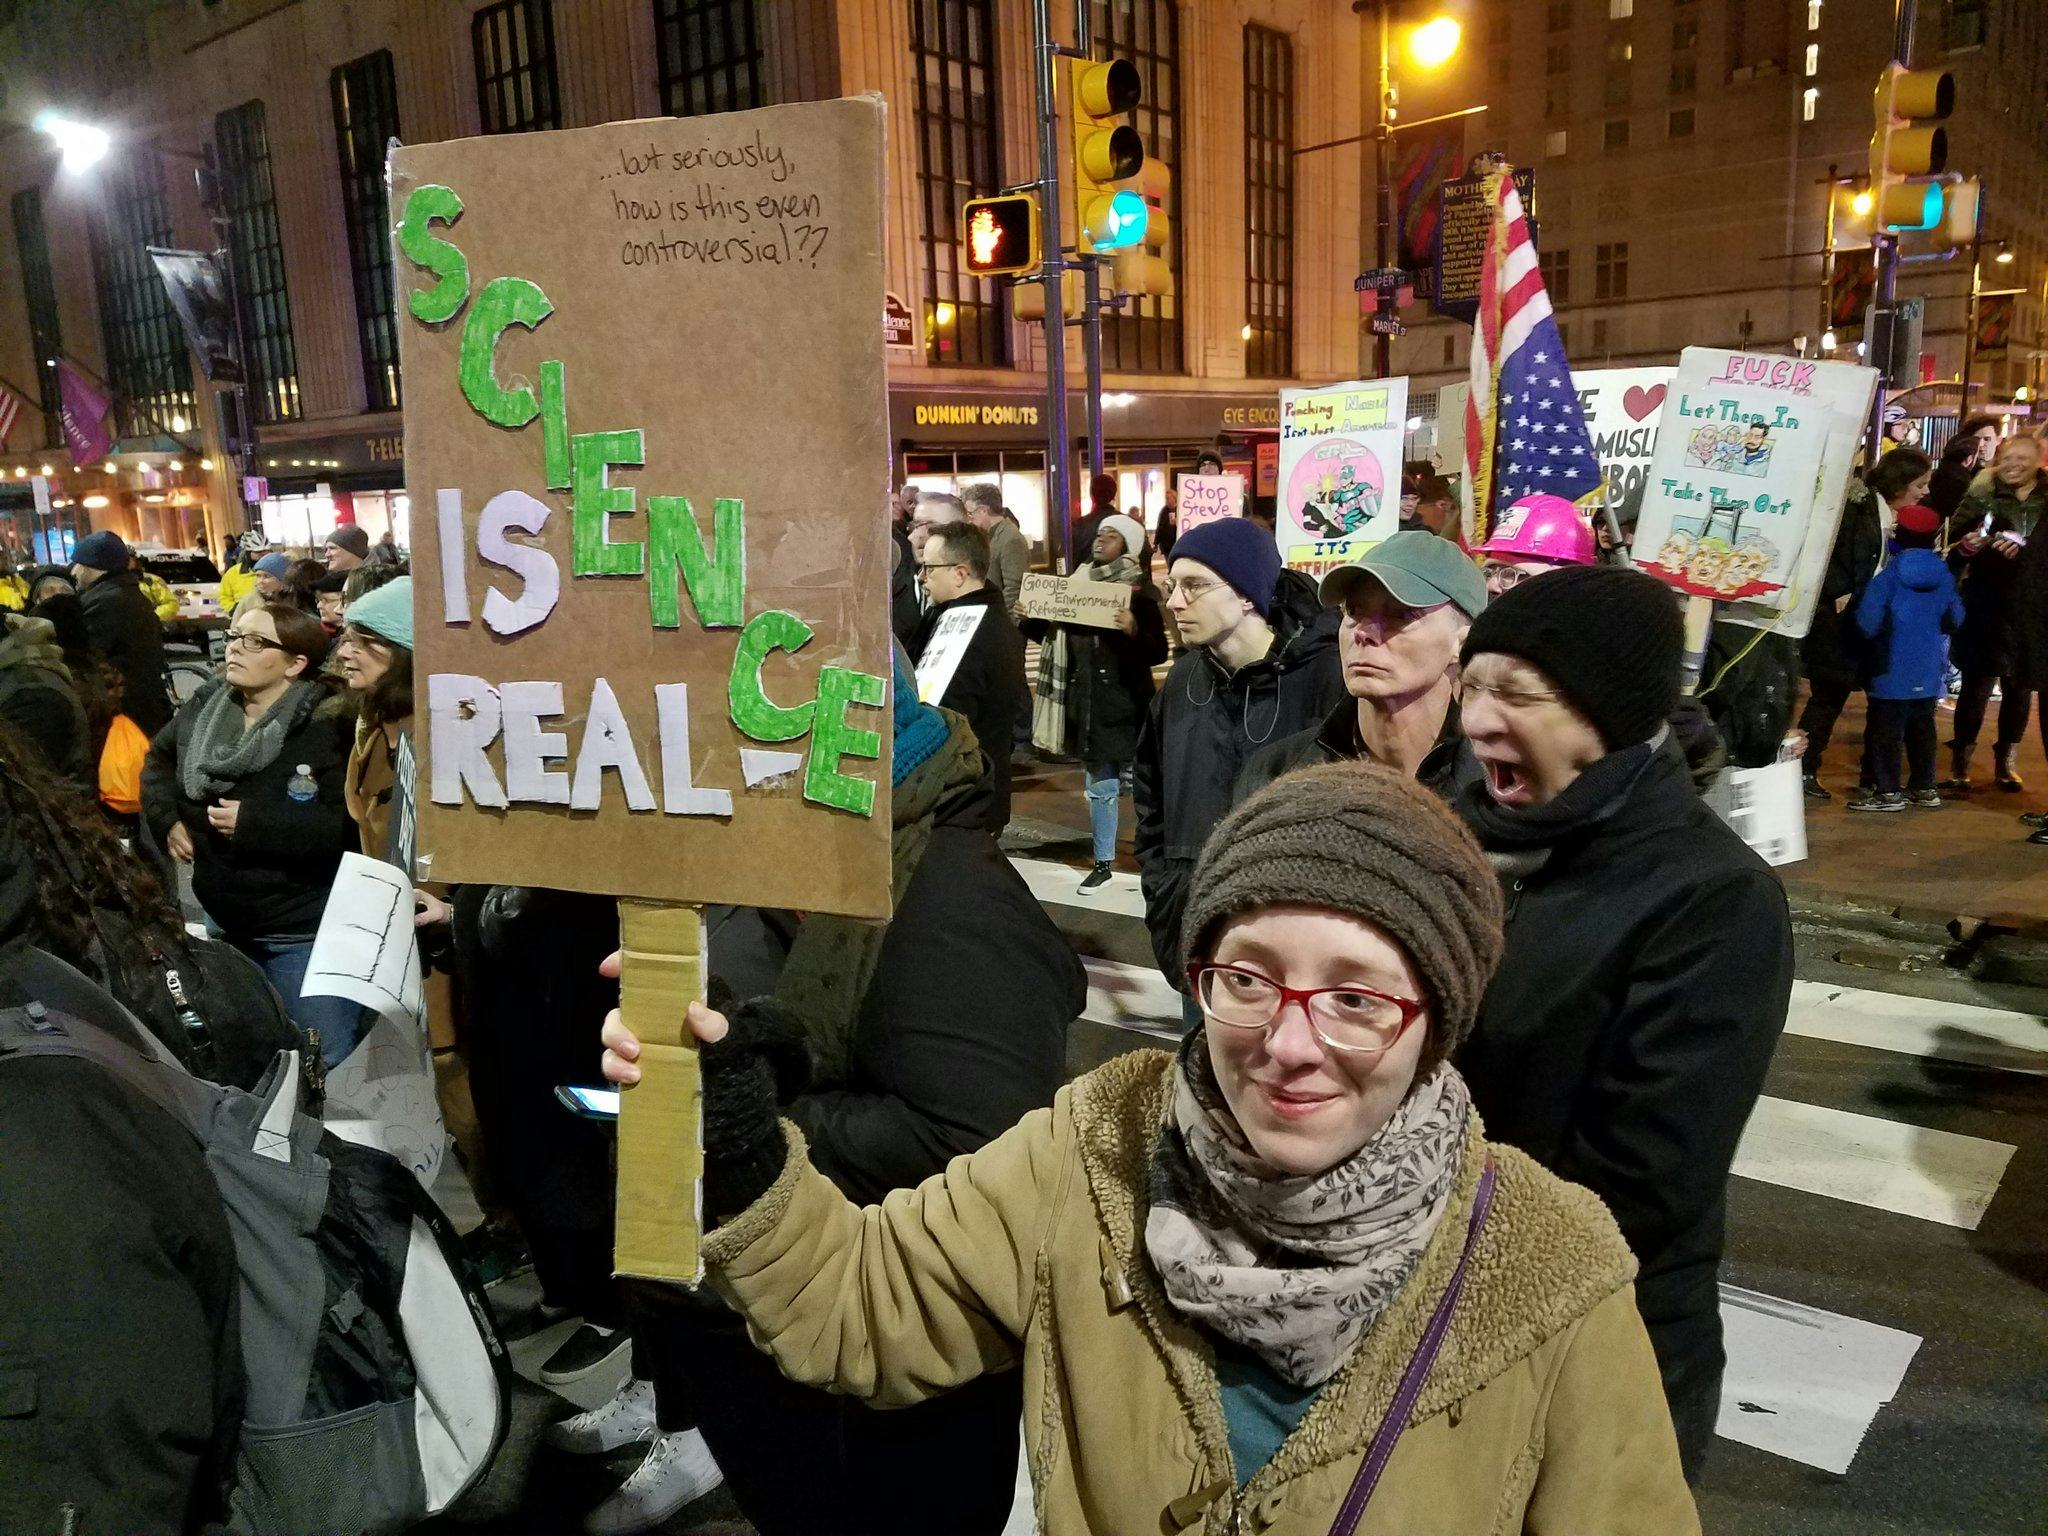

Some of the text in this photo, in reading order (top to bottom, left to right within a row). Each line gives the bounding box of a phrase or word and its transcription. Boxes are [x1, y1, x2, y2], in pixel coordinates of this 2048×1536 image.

[672, 128, 796, 183] seriously,
[610, 182, 821, 224] how is this even
[1444, 182, 1482, 198] MOTH
[621, 222, 830, 270] controversial??
[1356, 274, 1395, 290] JUNIPER
[1373, 319, 1400, 335] MARKET
[1726, 355, 1818, 388] FUCK
[915, 404, 1039, 425] DUNKIN' DONUTS
[1223, 407, 1246, 424] EYE
[1284, 400, 1334, 420] Punching
[1679, 393, 1801, 430] Let Them In
[366, 436, 403, 462] 7-ELE
[1594, 426, 1659, 459] MUSLI
[400, 183, 887, 818] SCIENCE
[1184, 478, 1229, 506] Stop
[1661, 478, 1704, 502] Take
[1754, 493, 1792, 516] Out
[1182, 500, 1233, 517] Steve
[1314, 540, 1352, 556] IT'S
[435, 488, 561, 636] IS
[1022, 574, 1069, 597] Google
[1028, 599, 1078, 620] Refugees
[428, 673, 734, 818] REAL
